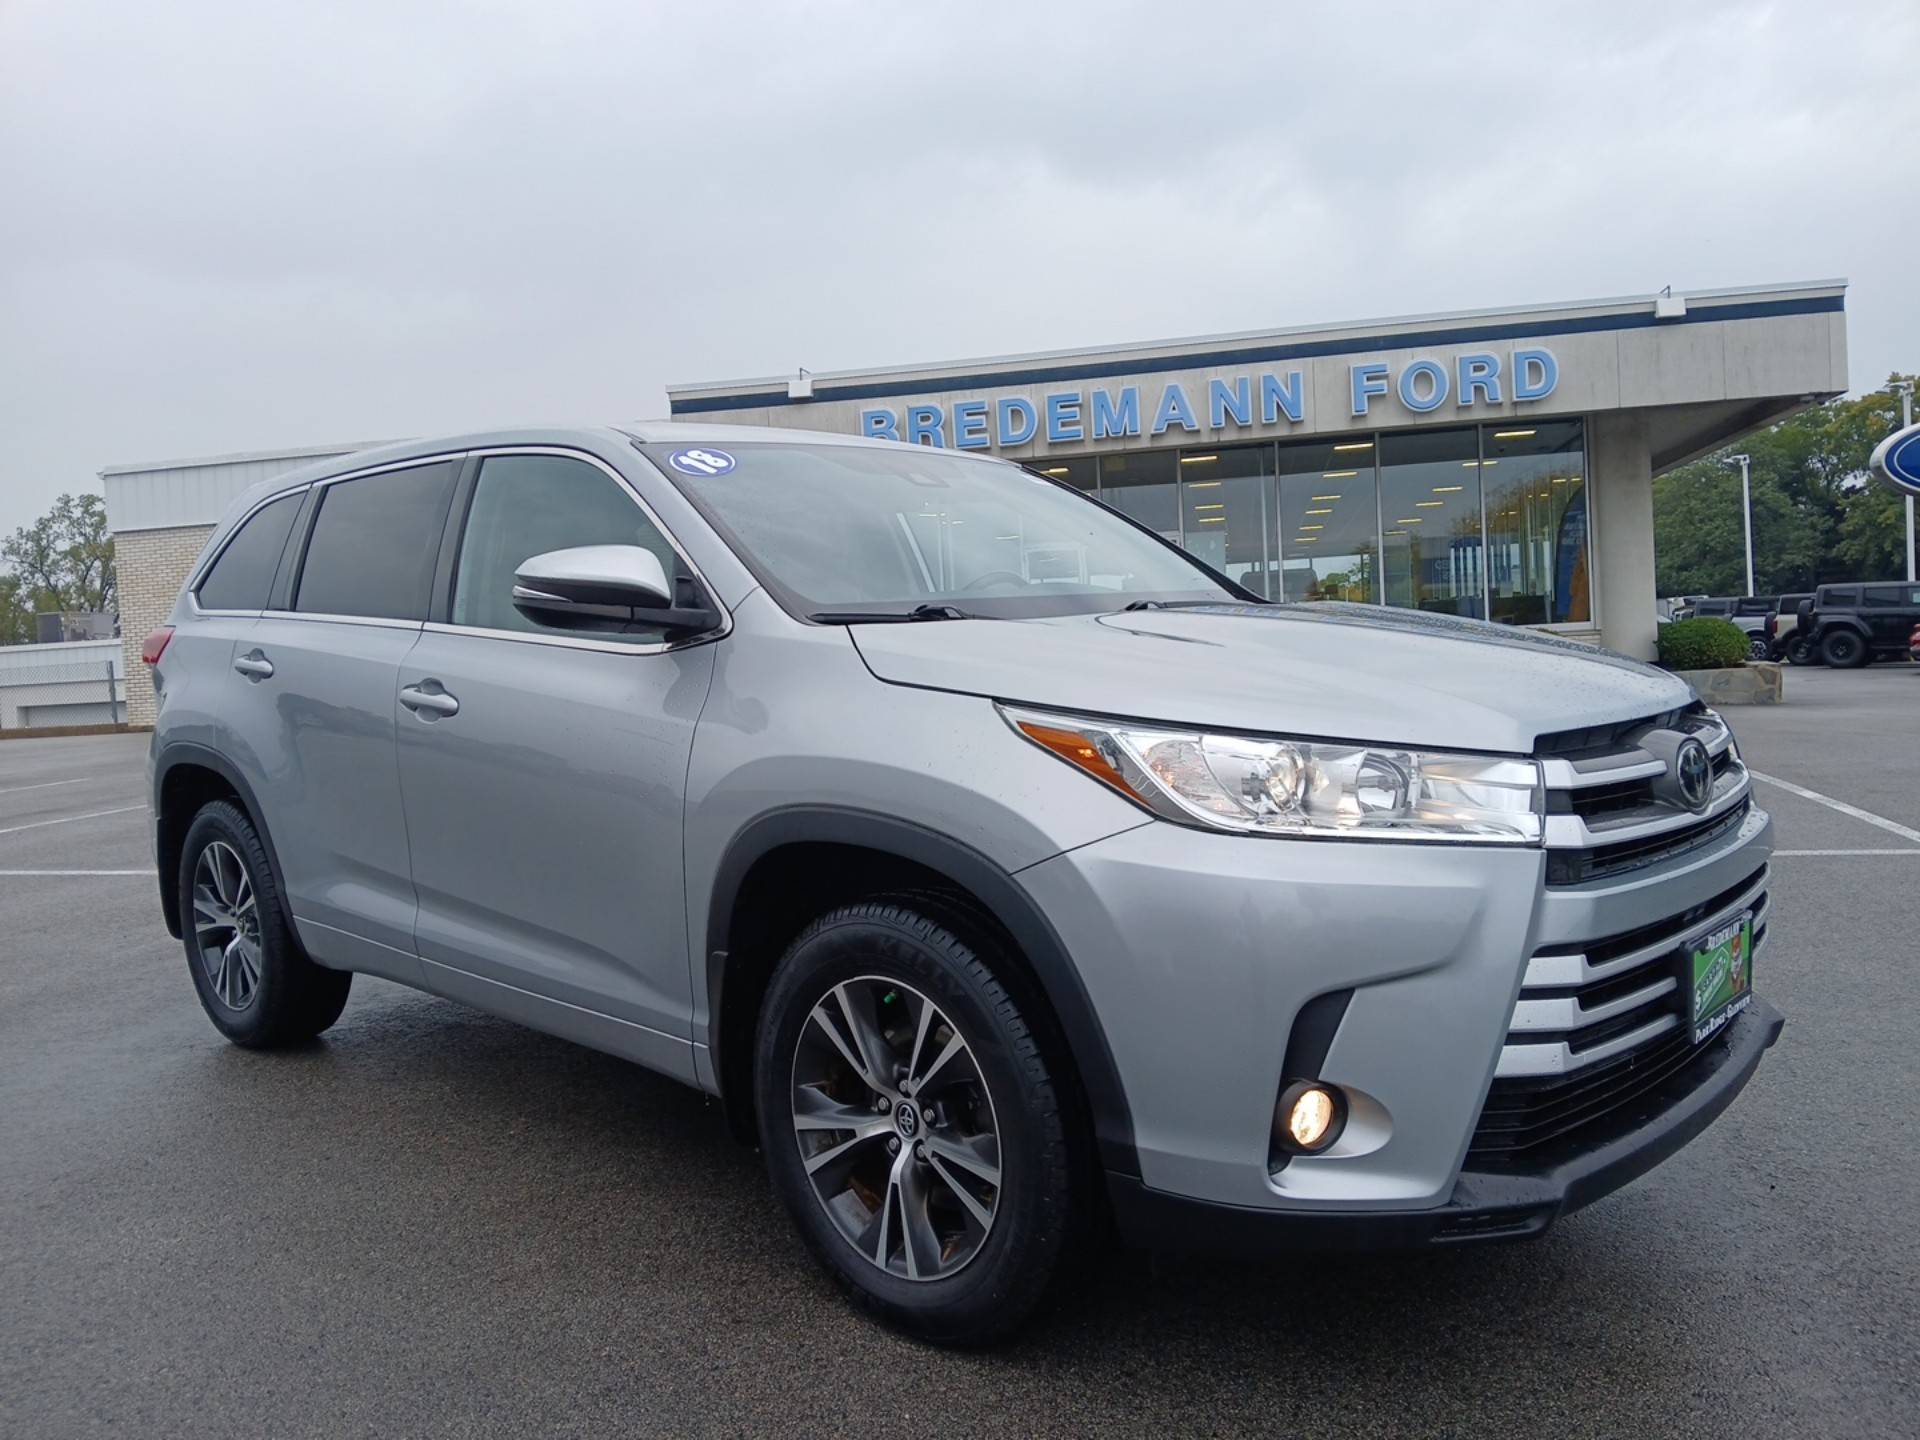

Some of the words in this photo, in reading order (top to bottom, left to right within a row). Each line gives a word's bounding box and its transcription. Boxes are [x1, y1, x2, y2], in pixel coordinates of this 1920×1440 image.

[860, 371, 1304, 449] BREDEMANN
[1351, 347, 1560, 417] FORD
[678, 450, 728, 474] 18
